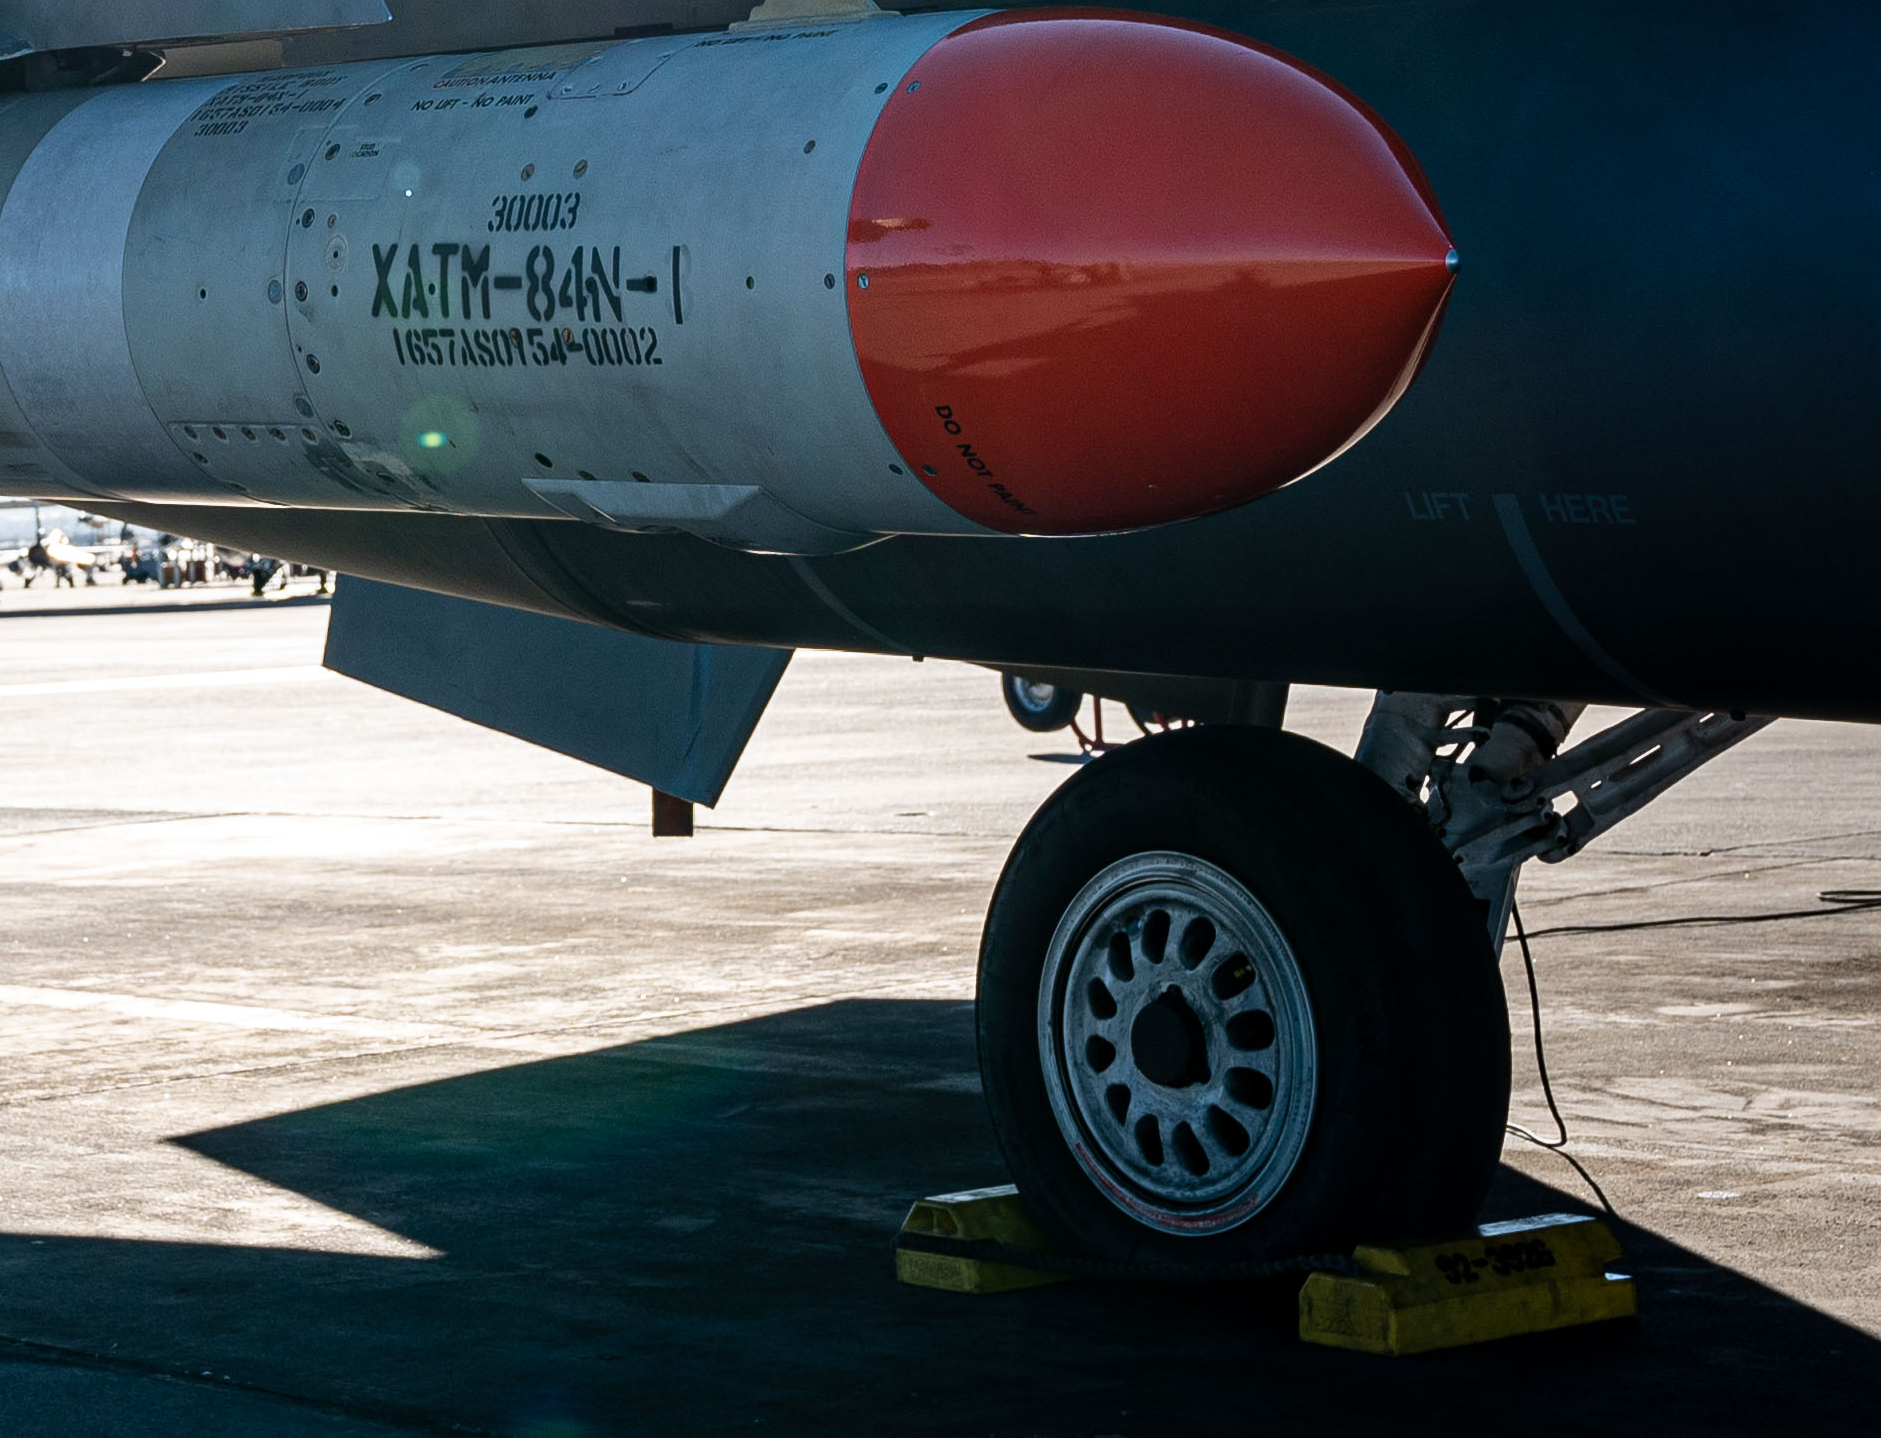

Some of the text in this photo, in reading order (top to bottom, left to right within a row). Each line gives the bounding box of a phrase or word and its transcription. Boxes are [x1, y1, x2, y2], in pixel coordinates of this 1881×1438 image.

[432, 71, 557, 90] CAUTION ANTENNA
[410, 99, 433, 112] NO
[434, 97, 461, 111] LIFT
[470, 96, 495, 109] NO
[498, 93, 535, 108] PAINT
[193, 120, 249, 137] 30003
[487, 192, 581, 232] 30003
[371, 243, 684, 325] XATM-84N-1
[934, 404, 1038, 515] DO NOT PAINT
[1404, 491, 1636, 524] LIFT HERE
